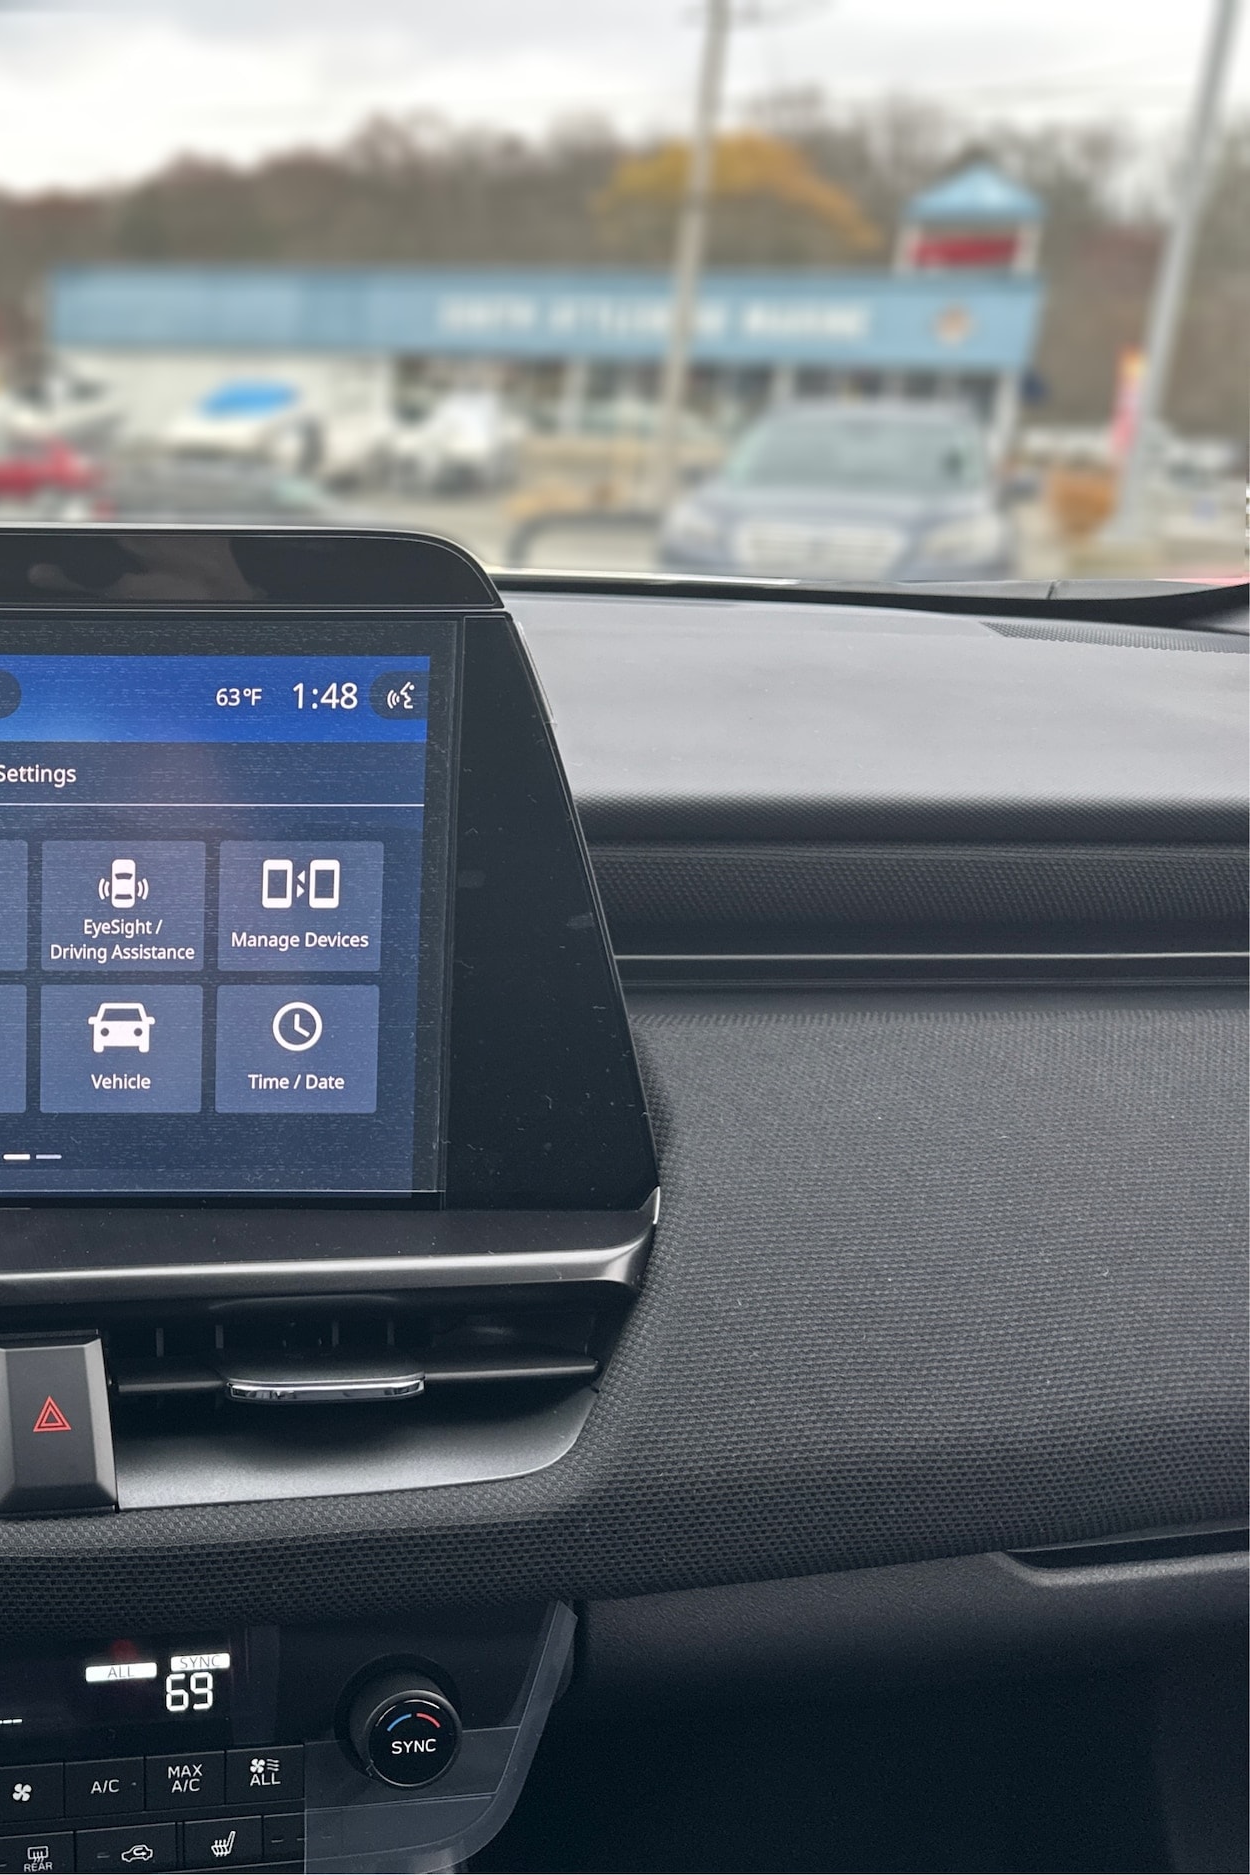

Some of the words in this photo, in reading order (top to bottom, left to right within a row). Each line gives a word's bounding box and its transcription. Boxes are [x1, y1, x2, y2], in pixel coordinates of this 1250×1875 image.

[215, 687, 263, 707] 63°F
[292, 682, 358, 710] 1:48
[83, 919, 152, 938] EyeSight
[155, 919, 163, 935] /
[231, 931, 300, 951] Manage
[304, 931, 369, 948] Devices
[50, 944, 107, 964] Driving
[111, 944, 195, 961] Assistance
[91, 1074, 151, 1090] Vehicle
[248, 1074, 290, 1090] Time
[293, 1074, 301, 1090] /
[305, 1074, 345, 1090] Date
[179, 1654, 222, 1670] SYNC
[107, 1666, 136, 1680] ALL
[165, 1671, 214, 1712] 69
[391, 1738, 438, 1756] SYNC
[167, 1764, 203, 1779] MAX
[90, 1779, 120, 1795] A/C
[171, 1778, 201, 1794] A/C
[250, 1773, 282, 1787] ALL
[23, 1861, 53, 1873] REAR
